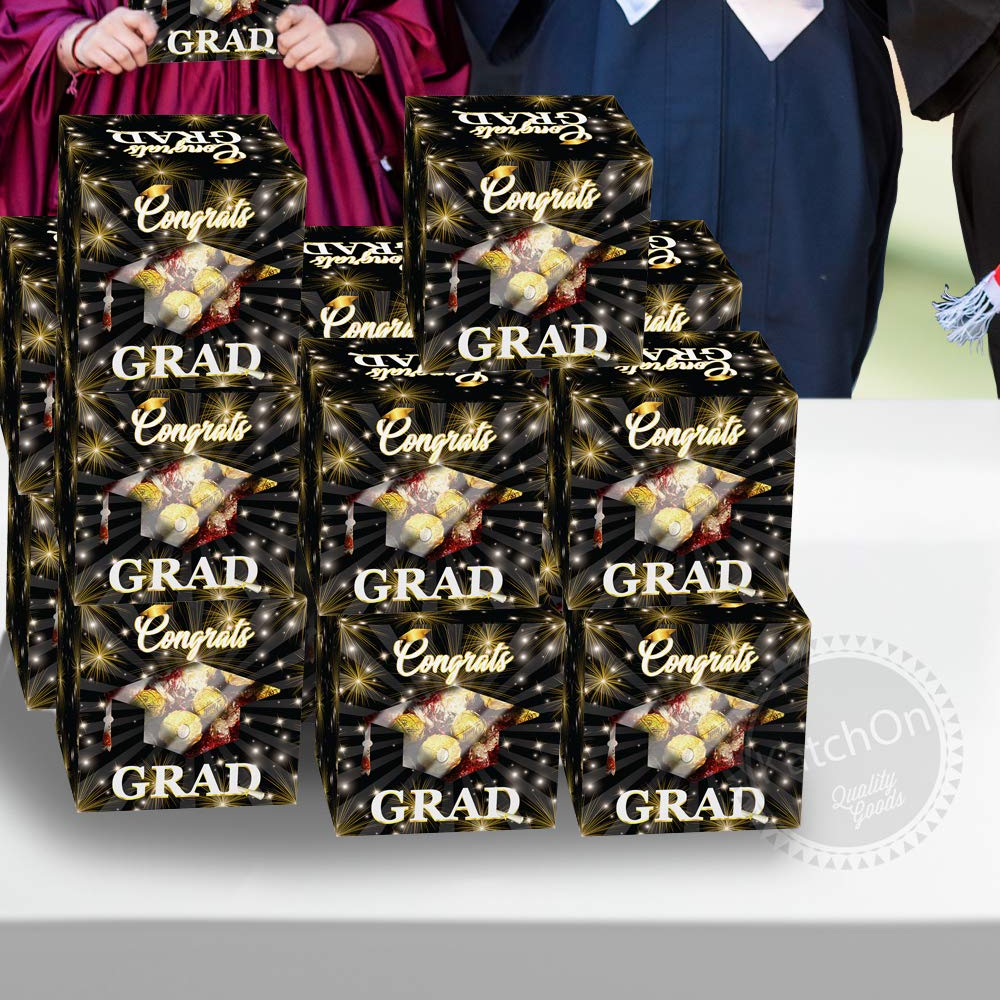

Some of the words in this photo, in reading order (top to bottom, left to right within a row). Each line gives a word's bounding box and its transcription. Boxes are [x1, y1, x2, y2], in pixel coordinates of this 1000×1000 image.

[167, 28, 276, 55] GRAD
[106, 129, 242, 145] GRAD
[453, 110, 588, 126] GRAD
[470, 121, 592, 145] Congrats
[124, 141, 247, 163] Congrats
[134, 192, 255, 241] Congrats
[480, 174, 601, 222] Congrats
[303, 241, 404, 255] RAD
[309, 252, 404, 271] ongrats
[111, 342, 265, 380] GRAD
[458, 323, 611, 362] GRAD
[643, 348, 732, 361] GRA
[132, 407, 251, 454] Congrats
[376, 418, 497, 465] Congrats
[625, 412, 746, 459] Congrats
[108, 555, 262, 594] GRAD
[354, 565, 507, 604] GRAD
[603, 559, 756, 598] GRAD
[134, 613, 255, 661] Congrats
[392, 638, 514, 685] Congrats
[638, 638, 759, 685] Congrats
[111, 762, 266, 802] GRAD
[371, 786, 524, 825] GRAD
[616, 786, 768, 825] GRAD
